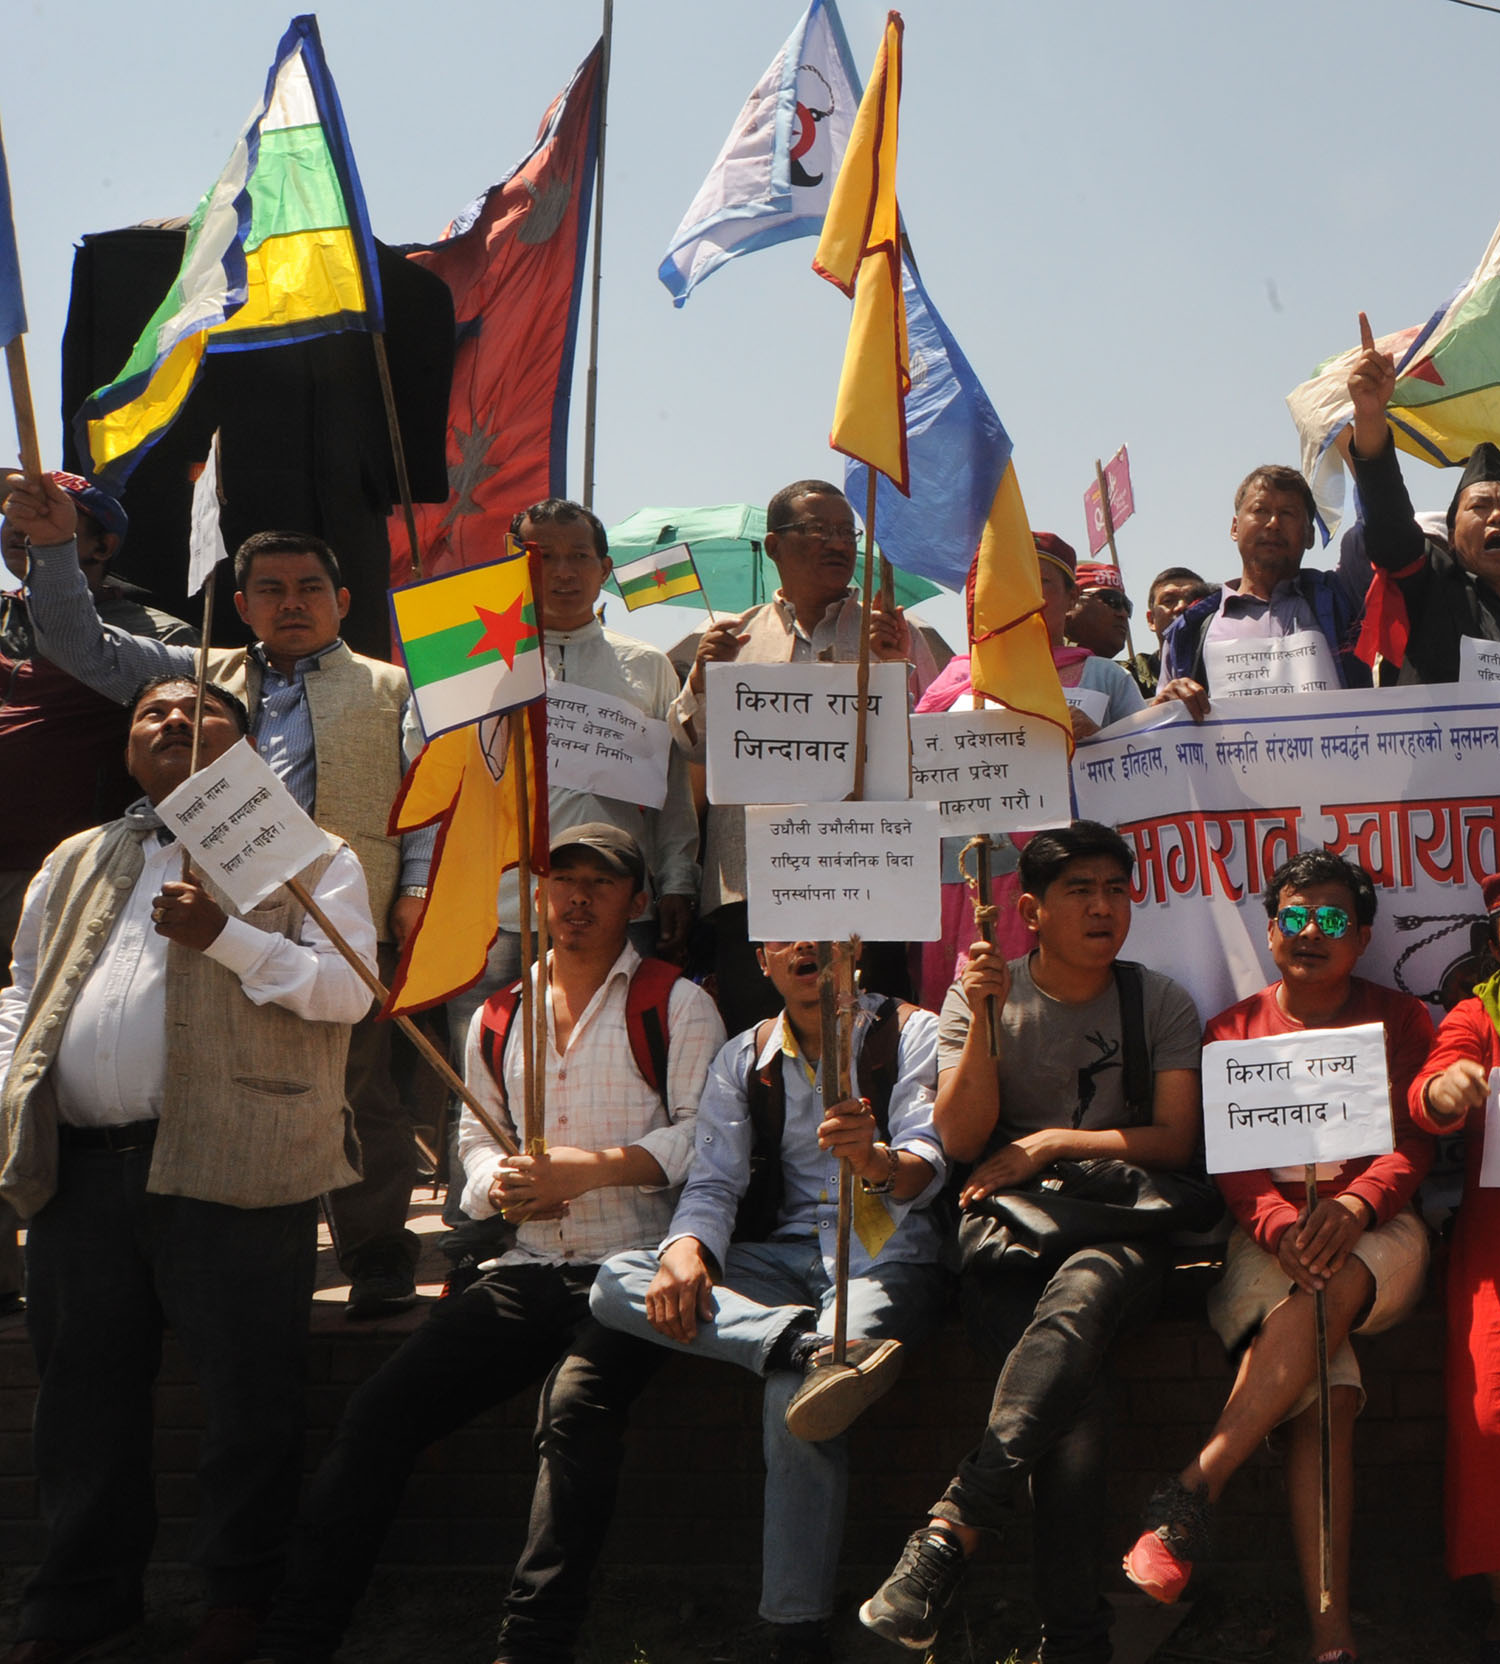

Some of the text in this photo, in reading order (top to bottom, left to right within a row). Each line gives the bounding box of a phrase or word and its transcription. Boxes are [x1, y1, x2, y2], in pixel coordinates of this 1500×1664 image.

[735, 682, 813, 714] किरात
[734, 730, 849, 762] जिन्दावाद
[954, 726, 1027, 750] प्रदेशलाई
[1215, 731, 1258, 773] संस्कृति
[1265, 733, 1313, 762] संरक्षण
[969, 760, 1009, 780] प्रदेश
[881, 818, 912, 835] दिइने
[818, 851, 879, 868] सार्वजनिक
[842, 888, 860, 900] गर
[1226, 1055, 1357, 1085] किरात राज्य
[1228, 1102, 1329, 1130] जिन्दावाद
